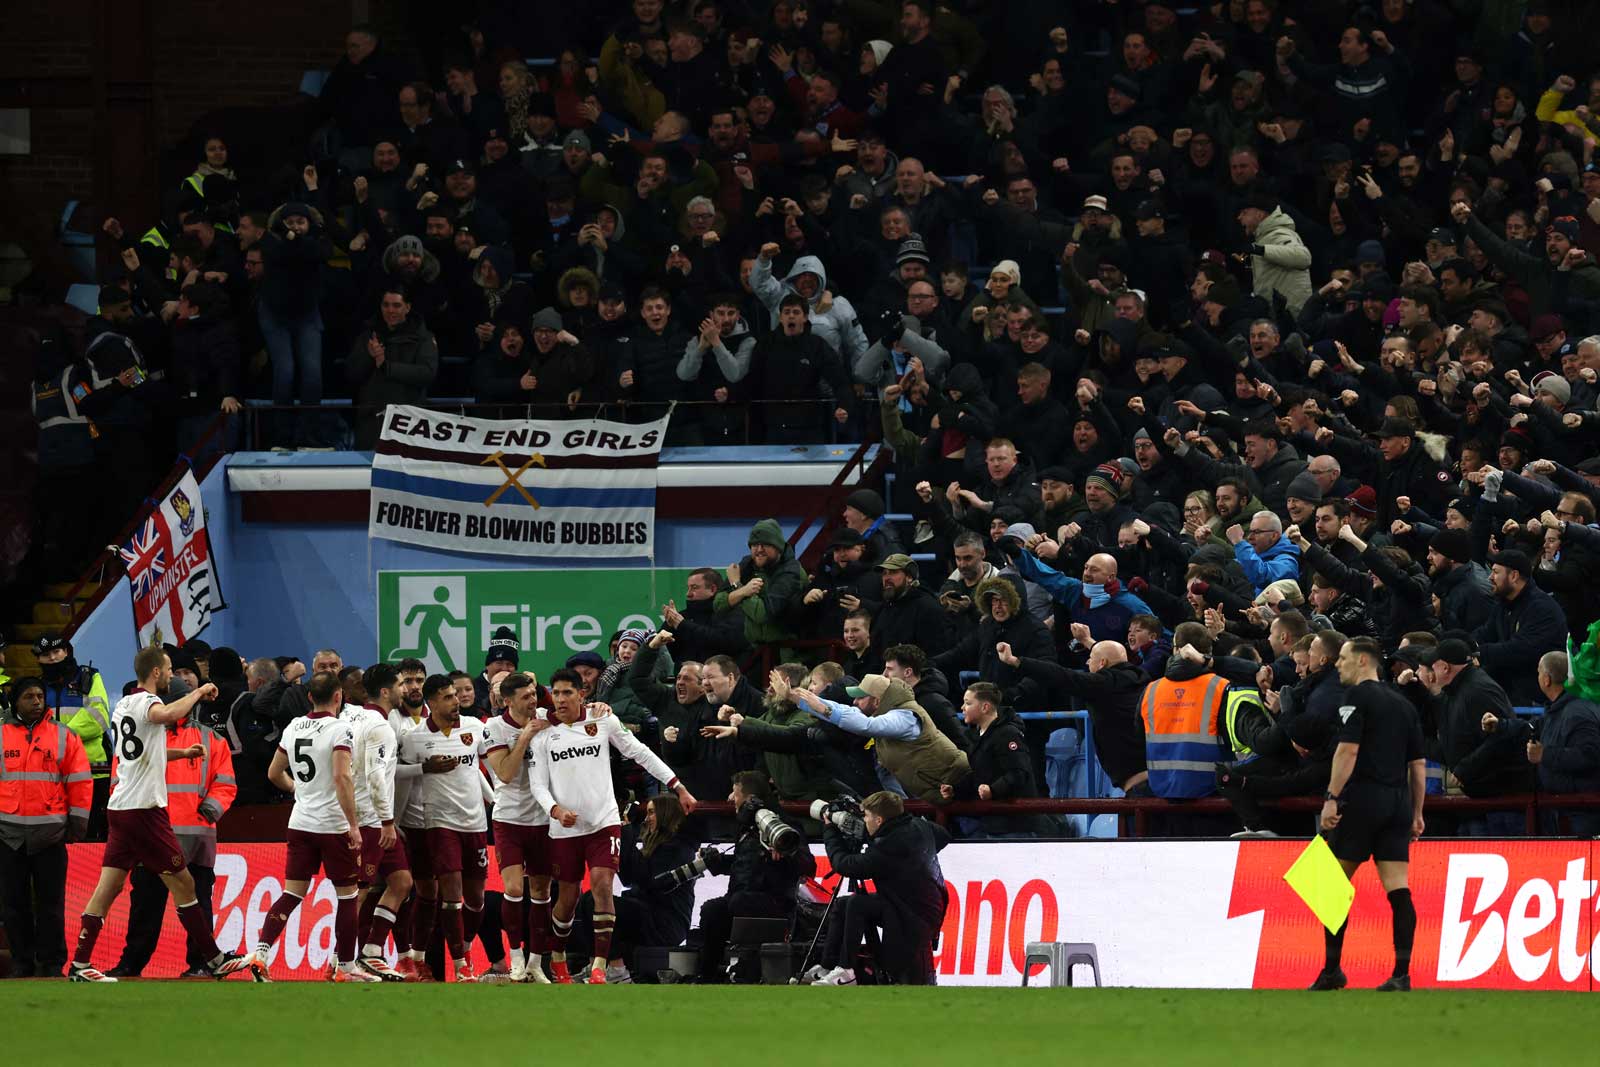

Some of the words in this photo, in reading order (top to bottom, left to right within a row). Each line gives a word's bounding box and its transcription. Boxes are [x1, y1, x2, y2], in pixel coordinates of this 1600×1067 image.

[388, 414, 477, 443] EAST
[482, 428, 551, 449] END
[562, 429, 659, 450] GIRLS
[376, 501, 461, 533] FOREVER
[464, 514, 556, 545] BLOWING
[560, 521, 648, 545] BUBBLES
[480, 604, 603, 652] Fire
[294, 738, 317, 783] 5
[550, 744, 602, 762] betway
[609, 836, 621, 857] 19
